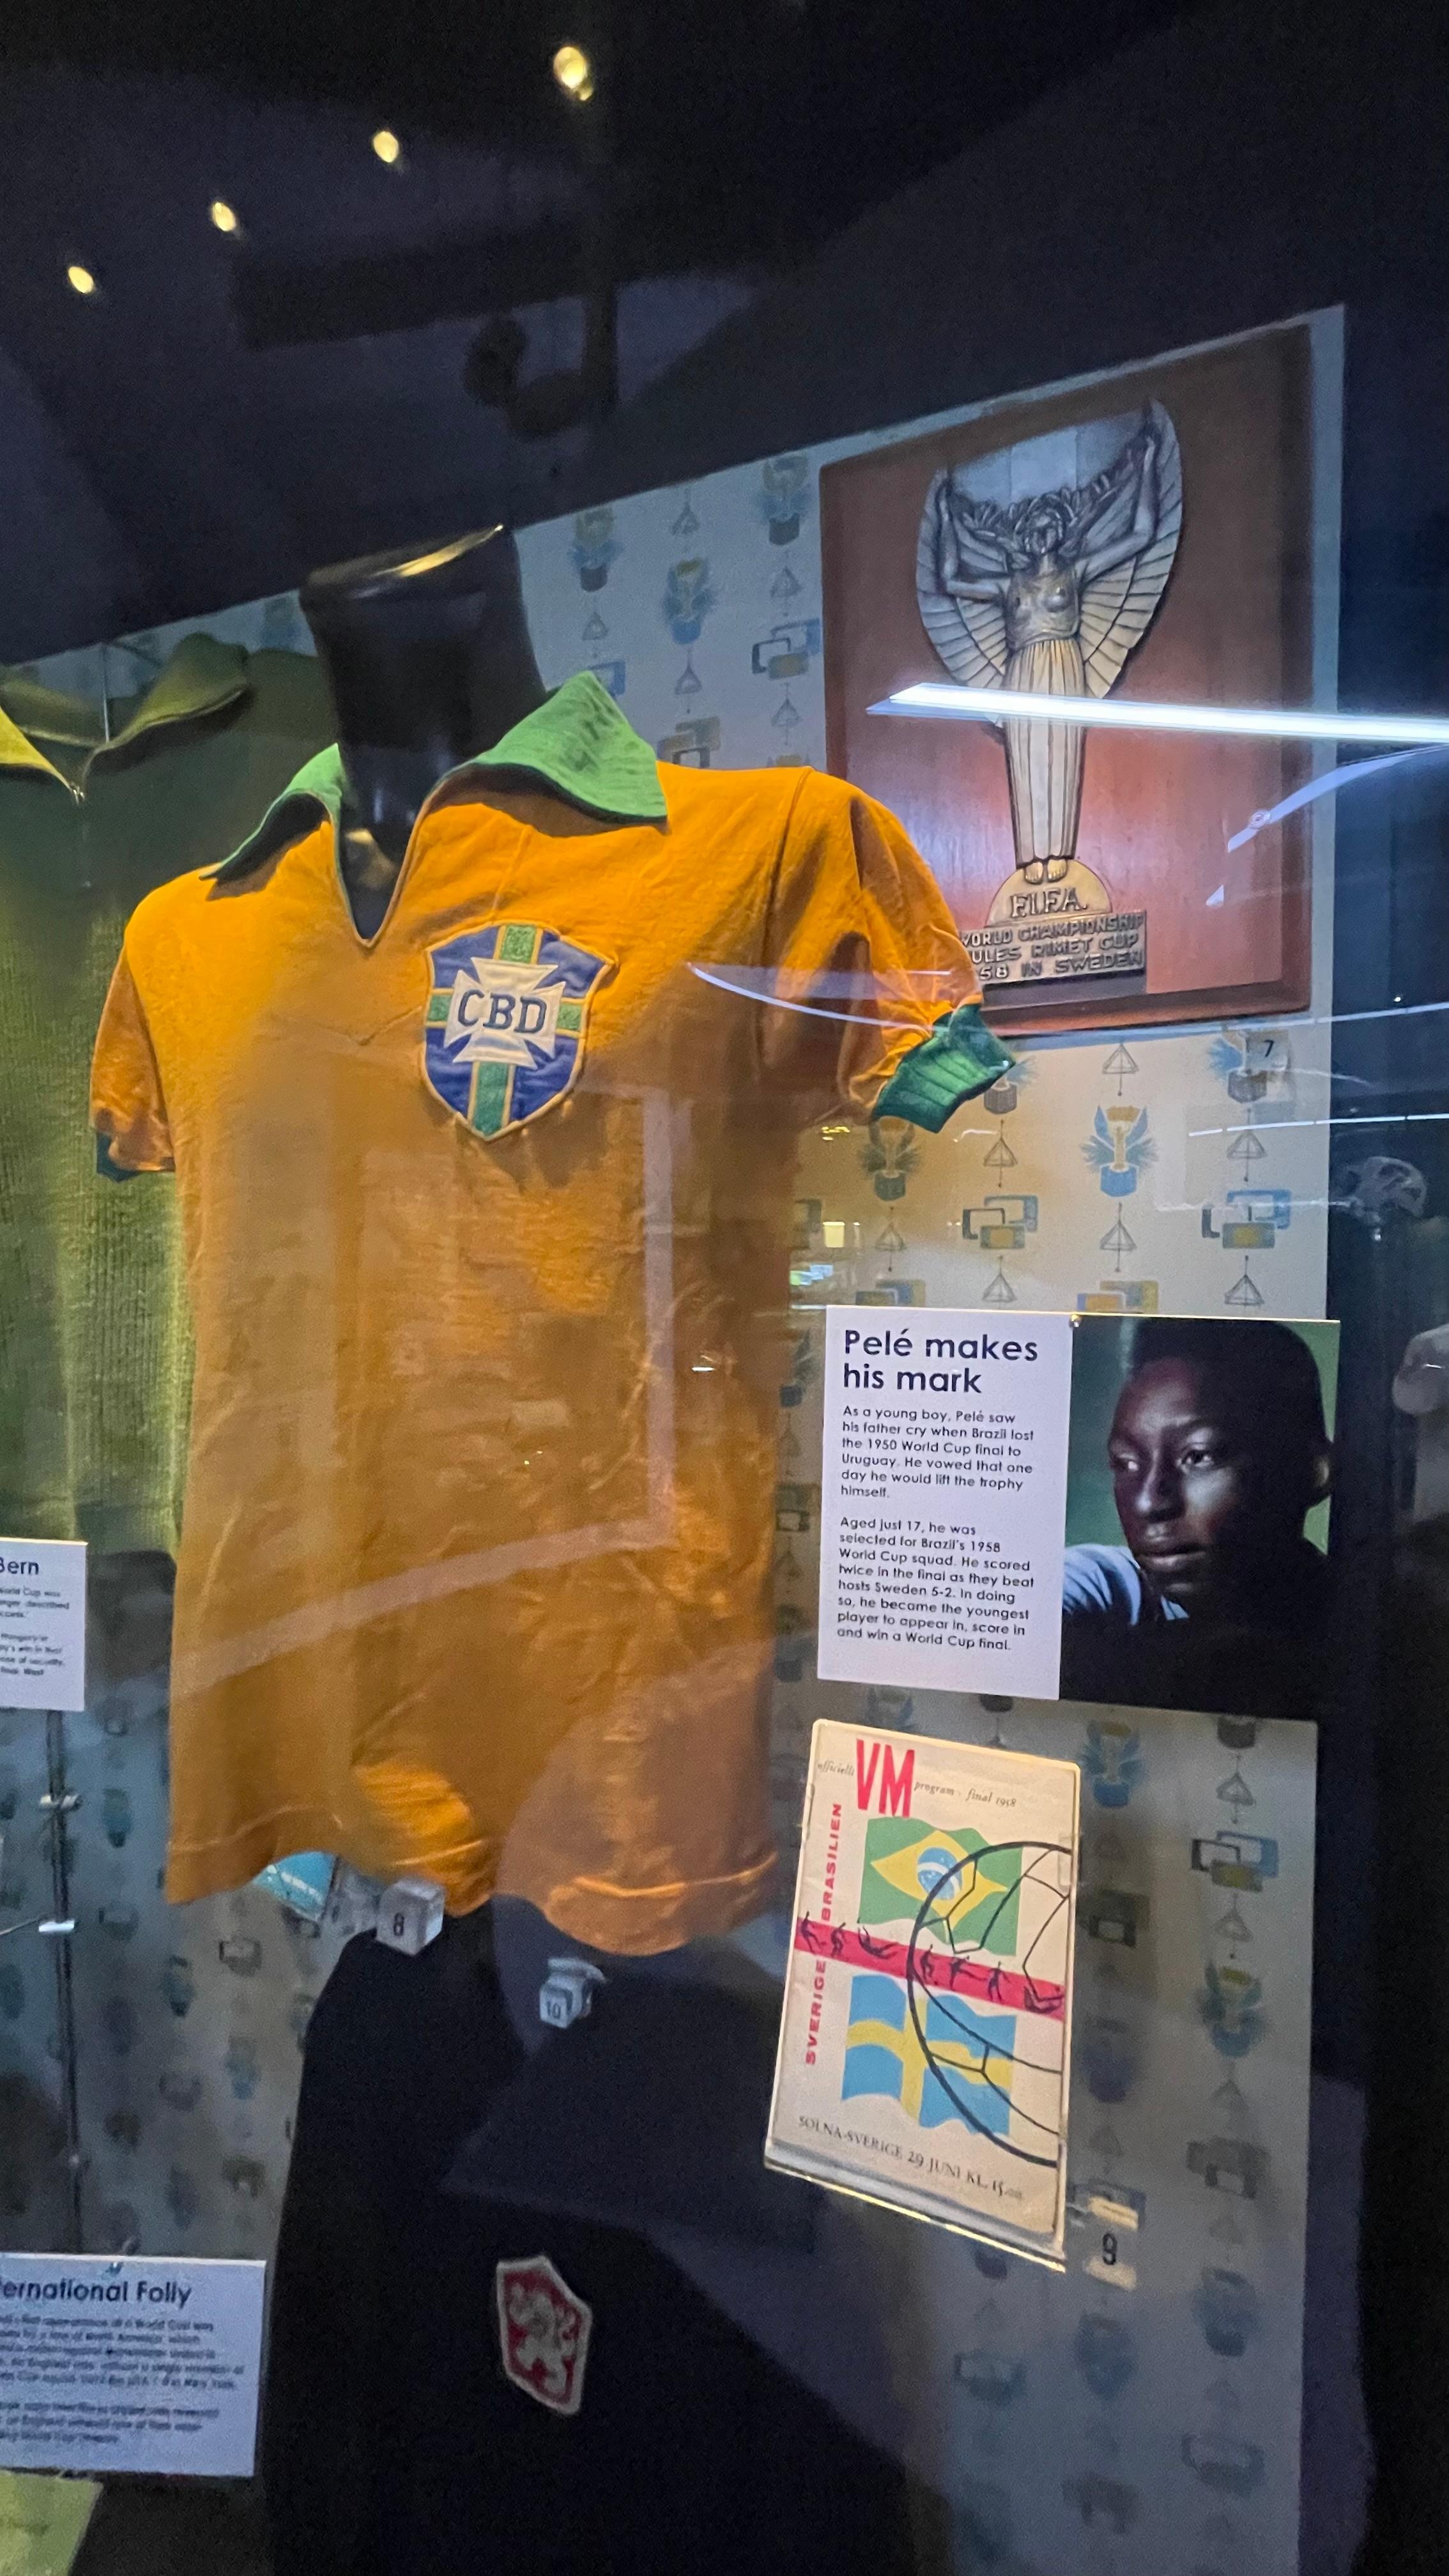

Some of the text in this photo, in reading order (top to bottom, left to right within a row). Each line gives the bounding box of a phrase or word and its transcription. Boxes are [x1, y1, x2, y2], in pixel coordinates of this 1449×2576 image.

[1018, 913, 1144, 941] CHAMPIONSHIP
[971, 933, 1138, 964] ULES RIMET CUP
[979, 949, 1145, 981] 58 IN SWEDEN
[457, 989, 548, 1034] CBD
[1264, 1039, 1275, 1057] 7
[845, 1329, 1038, 1361] Pelé makes
[843, 1363, 982, 1393] his mark
[843, 1406, 858, 1416] As
[876, 1409, 917, 1422] young
[923, 1409, 951, 1423] boy,
[956, 1410, 984, 1422] Pelé
[989, 1414, 1015, 1423] saw
[843, 1421, 1033, 1441] his father cry when Brazil lost
[843, 1438, 1021, 1456] the 1950 World Cup final to
[842, 1453, 1033, 1473] Uruguay. He vowed that one
[841, 1469, 1023, 1492] day he would lift the trophy
[841, 1484, 890, 1498] himself.
[841, 1517, 976, 1535] Aged just 17, he was
[839, 1533, 1000, 1552] selected for Brazil's 1958
[0, 1557, 39, 1575] Bern
[839, 1547, 1030, 1571] World Cup squad. He scored
[839, 1563, 1034, 1587] twice in the final as they beat
[838, 1579, 1015, 1605] hosts Sweden 5-2. In doing
[838, 1597, 1029, 1620] so, he became the youngest
[838, 1611, 1025, 1636] player to appear in, score in
[837, 1629, 1011, 1650] and win a World Cup final.
[857, 1739, 915, 1818] VM
[914, 1781, 954, 1796] program
[965, 1788, 993, 1802] final
[996, 1797, 1016, 1807] 1958
[393, 1912, 405, 1936] 8
[806, 1804, 842, 2065] SVERIGE BRASILIEN
[546, 2000, 562, 2019] 10
[908, 2150, 924, 2167] 29
[929, 2156, 960, 2179] JUNI
[1103, 2232, 1117, 2266] 9
[0, 2277, 192, 2308] ernational Folly
